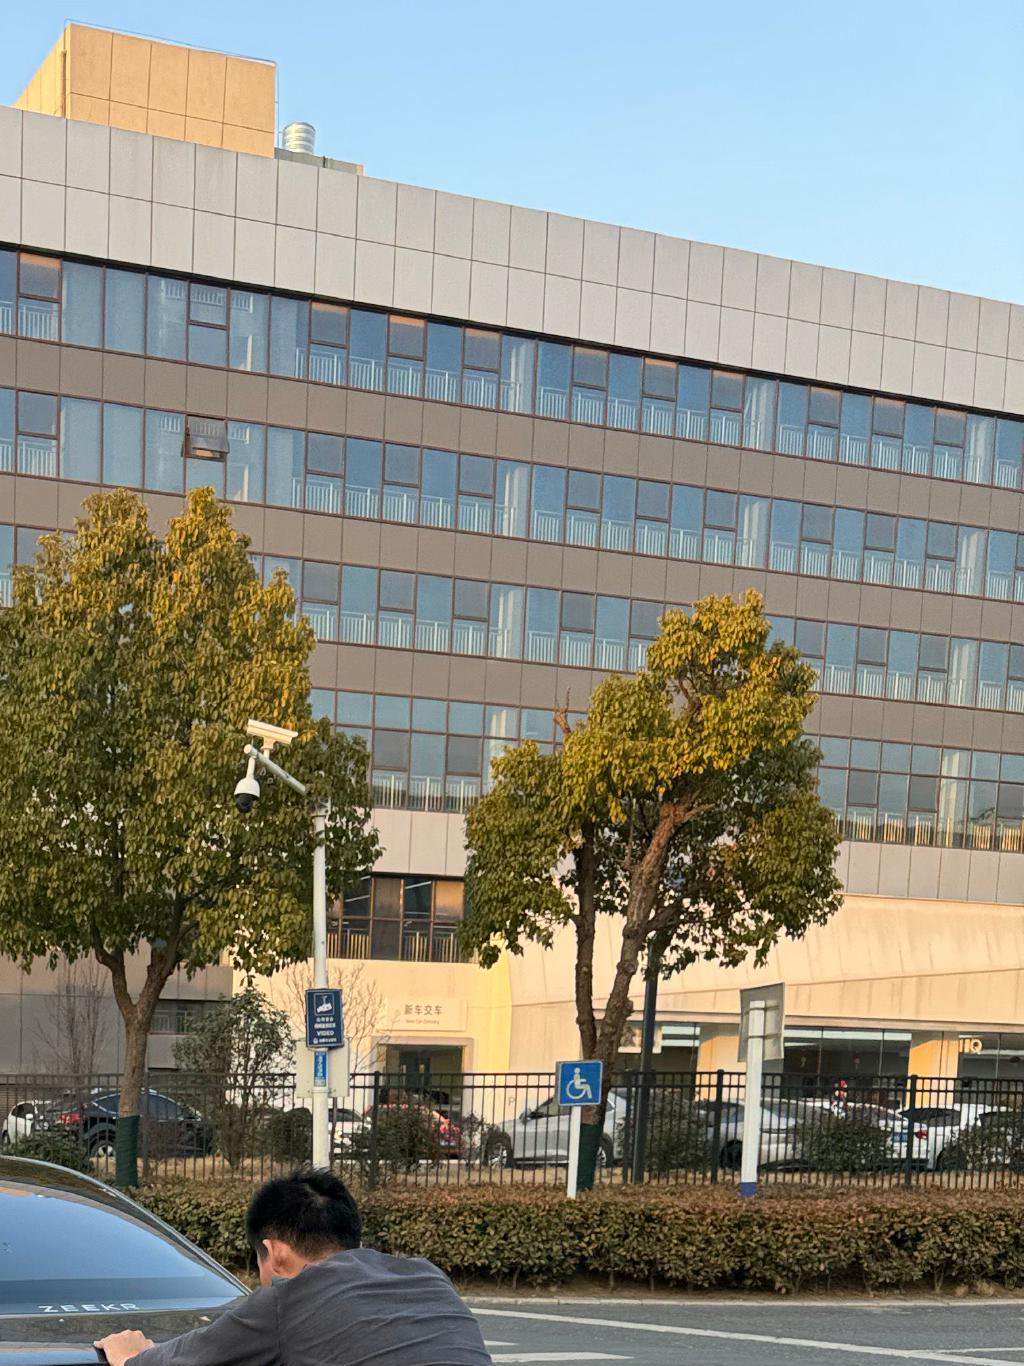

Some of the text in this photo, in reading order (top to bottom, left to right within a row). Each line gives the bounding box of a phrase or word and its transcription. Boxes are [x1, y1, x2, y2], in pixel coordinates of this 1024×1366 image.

[404, 1004, 443, 1016] 新车交车
[38, 1303, 141, 1313] ZEEKR
